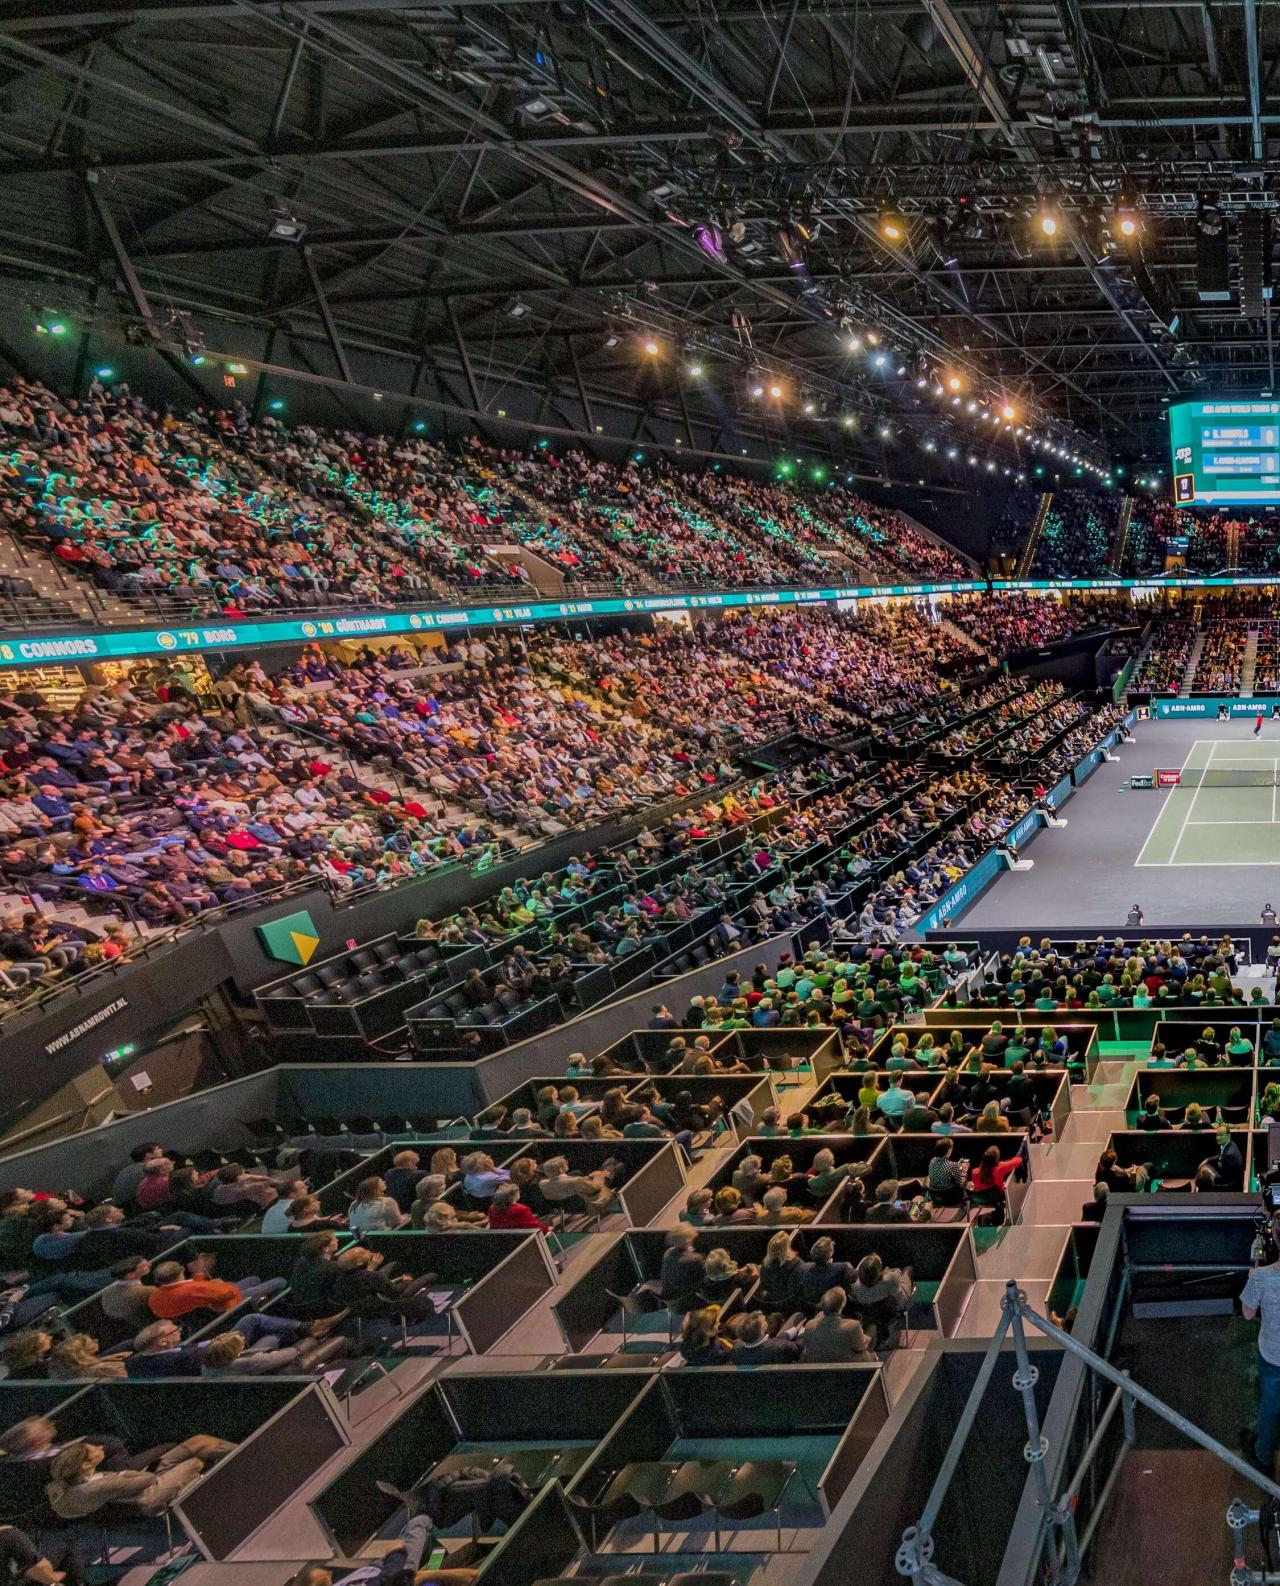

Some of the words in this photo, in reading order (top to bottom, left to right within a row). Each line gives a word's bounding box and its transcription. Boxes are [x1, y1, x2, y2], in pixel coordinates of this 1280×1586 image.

[180, 631, 199, 646] '79
[20, 639, 98, 659] CONNORS
[45, 997, 128, 1054] WWW.ABNAMROWTT.NL
